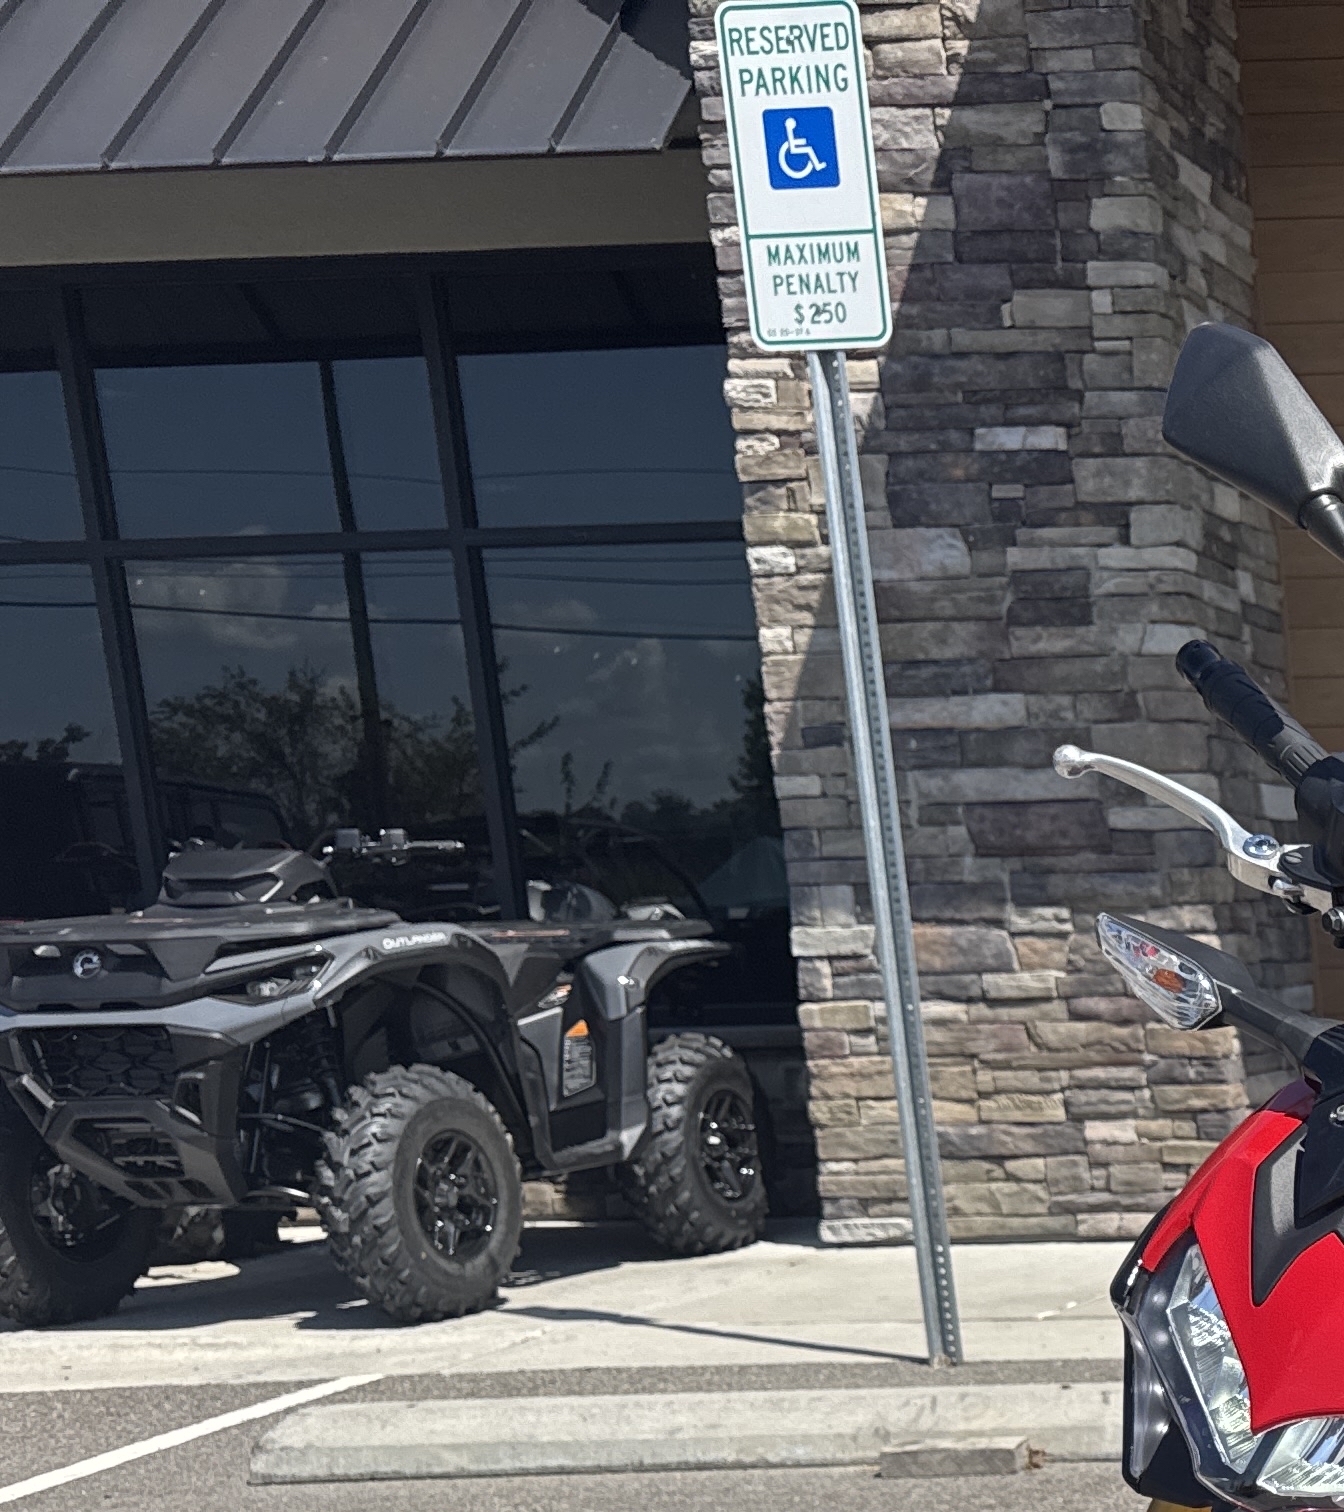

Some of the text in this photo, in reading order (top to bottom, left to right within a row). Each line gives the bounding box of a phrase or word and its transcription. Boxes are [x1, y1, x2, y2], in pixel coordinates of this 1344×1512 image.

[728, 22, 849, 57] RESERVED
[738, 63, 849, 98] PARKING
[766, 241, 861, 267] MAXIMUM
[772, 272, 860, 297] PENALTY
[793, 301, 848, 326] $250
